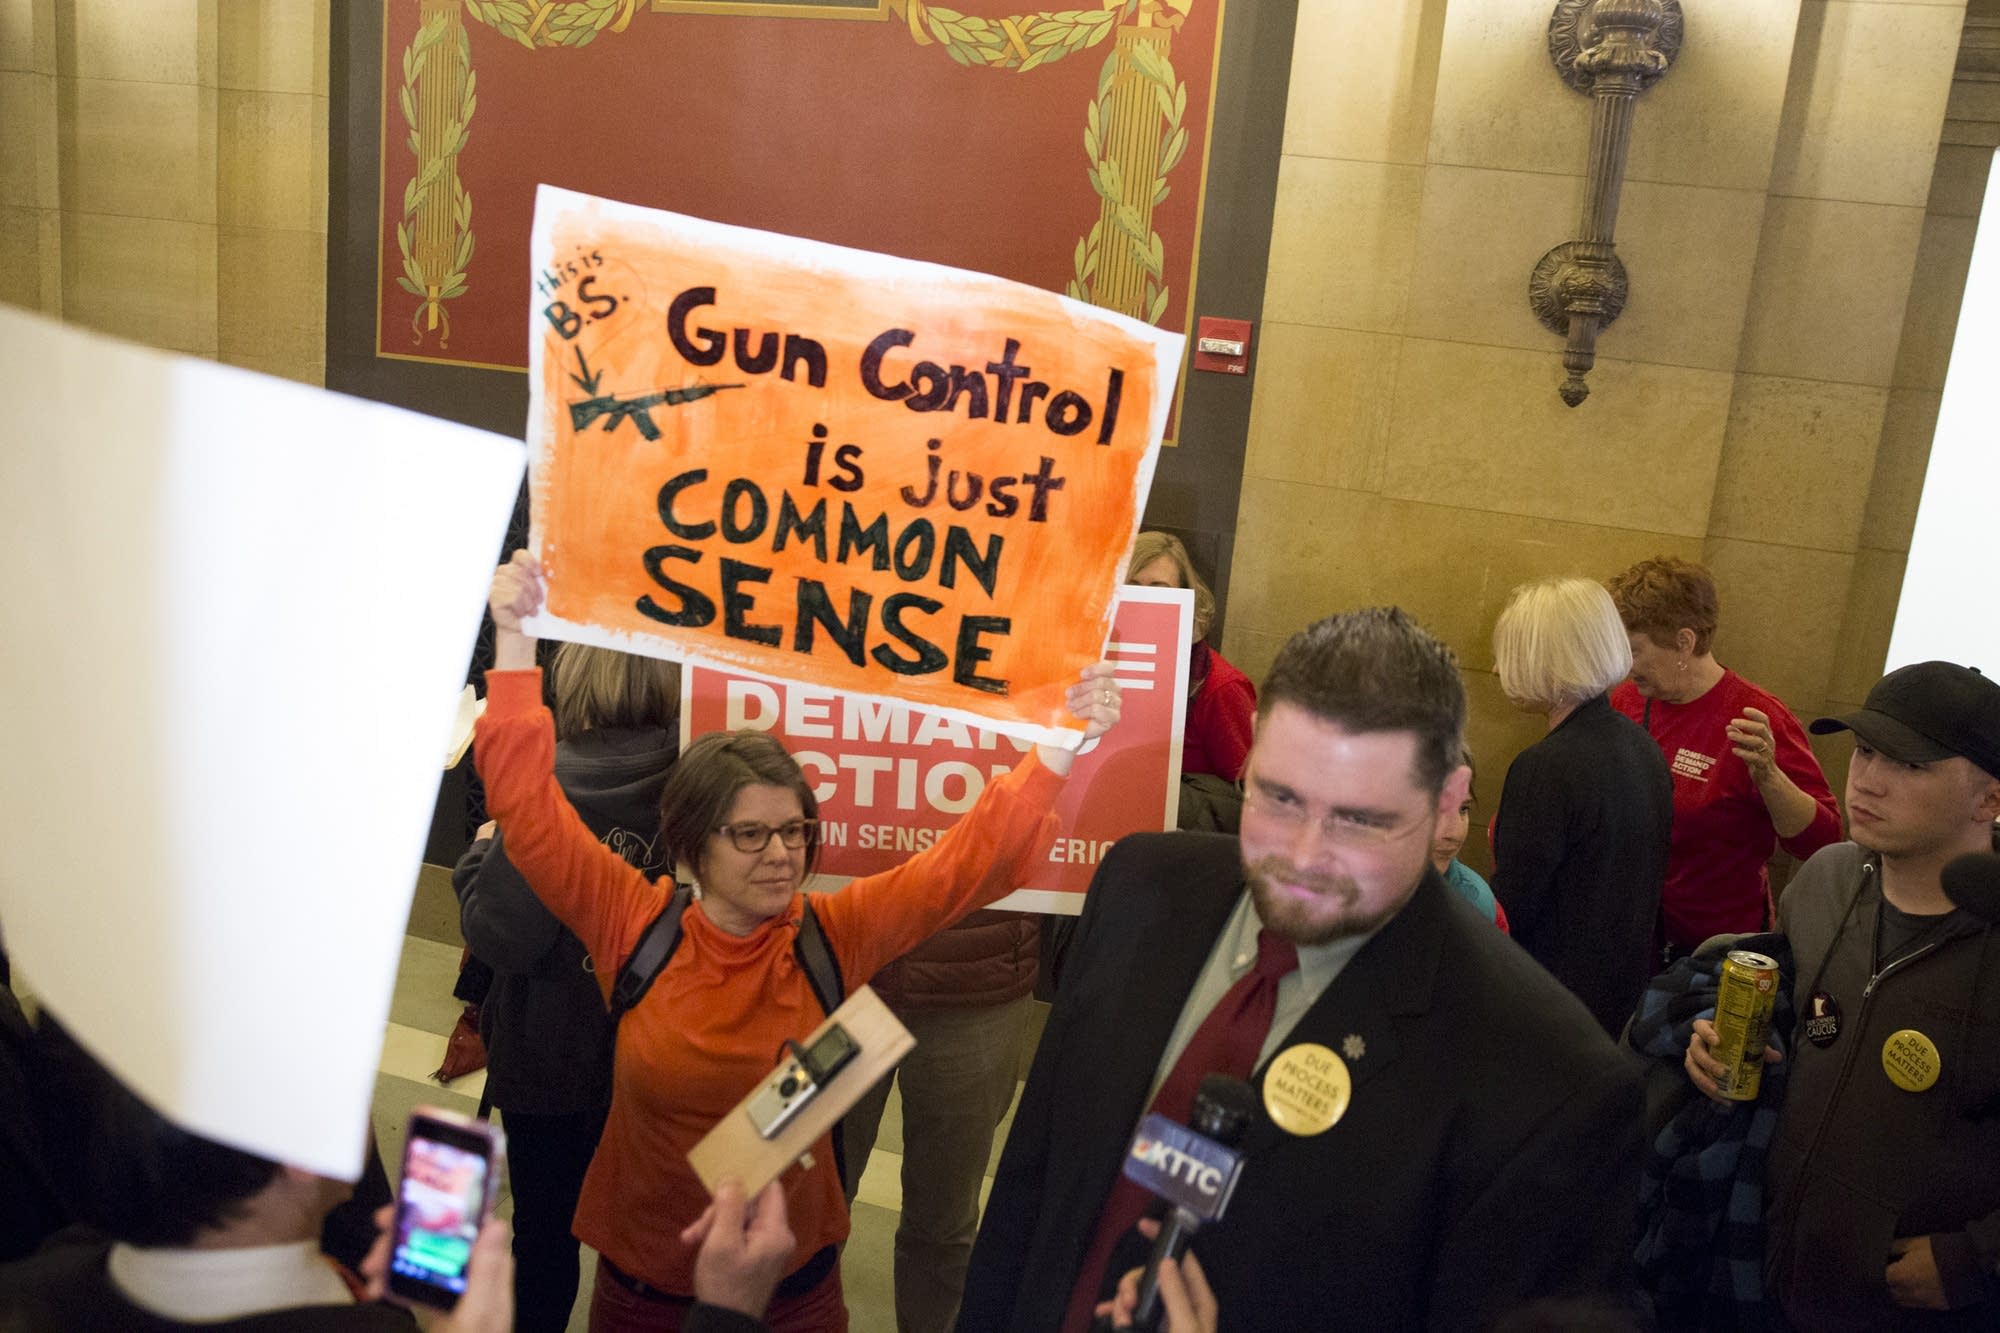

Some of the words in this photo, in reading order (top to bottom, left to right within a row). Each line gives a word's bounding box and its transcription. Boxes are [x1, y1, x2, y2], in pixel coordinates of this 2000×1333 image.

[537, 262, 578, 298] this
[576, 245, 603, 268] is
[667, 286, 828, 388] Gun
[860, 328, 1125, 446] Control
[803, 423, 864, 492] is
[900, 438, 1066, 522] just
[657, 468, 1004, 599] COMMON
[635, 545, 1011, 697] SENSE
[726, 679, 1101, 756] DEMA
[791, 750, 1014, 814] CTIO
[817, 820, 848, 847] UN
[1807, 1023, 1837, 1038] CAUCUS
[1908, 1038, 1928, 1057] DUE
[1304, 1053, 1333, 1075] DUE
[1887, 1050, 1925, 1082] MATTERS
[1893, 1039, 1932, 1073] PROCESS
[1275, 1077, 1330, 1116] MATTERS
[1282, 1060, 1340, 1099] PROCESS
[1151, 1140, 1222, 1195] KTTC
